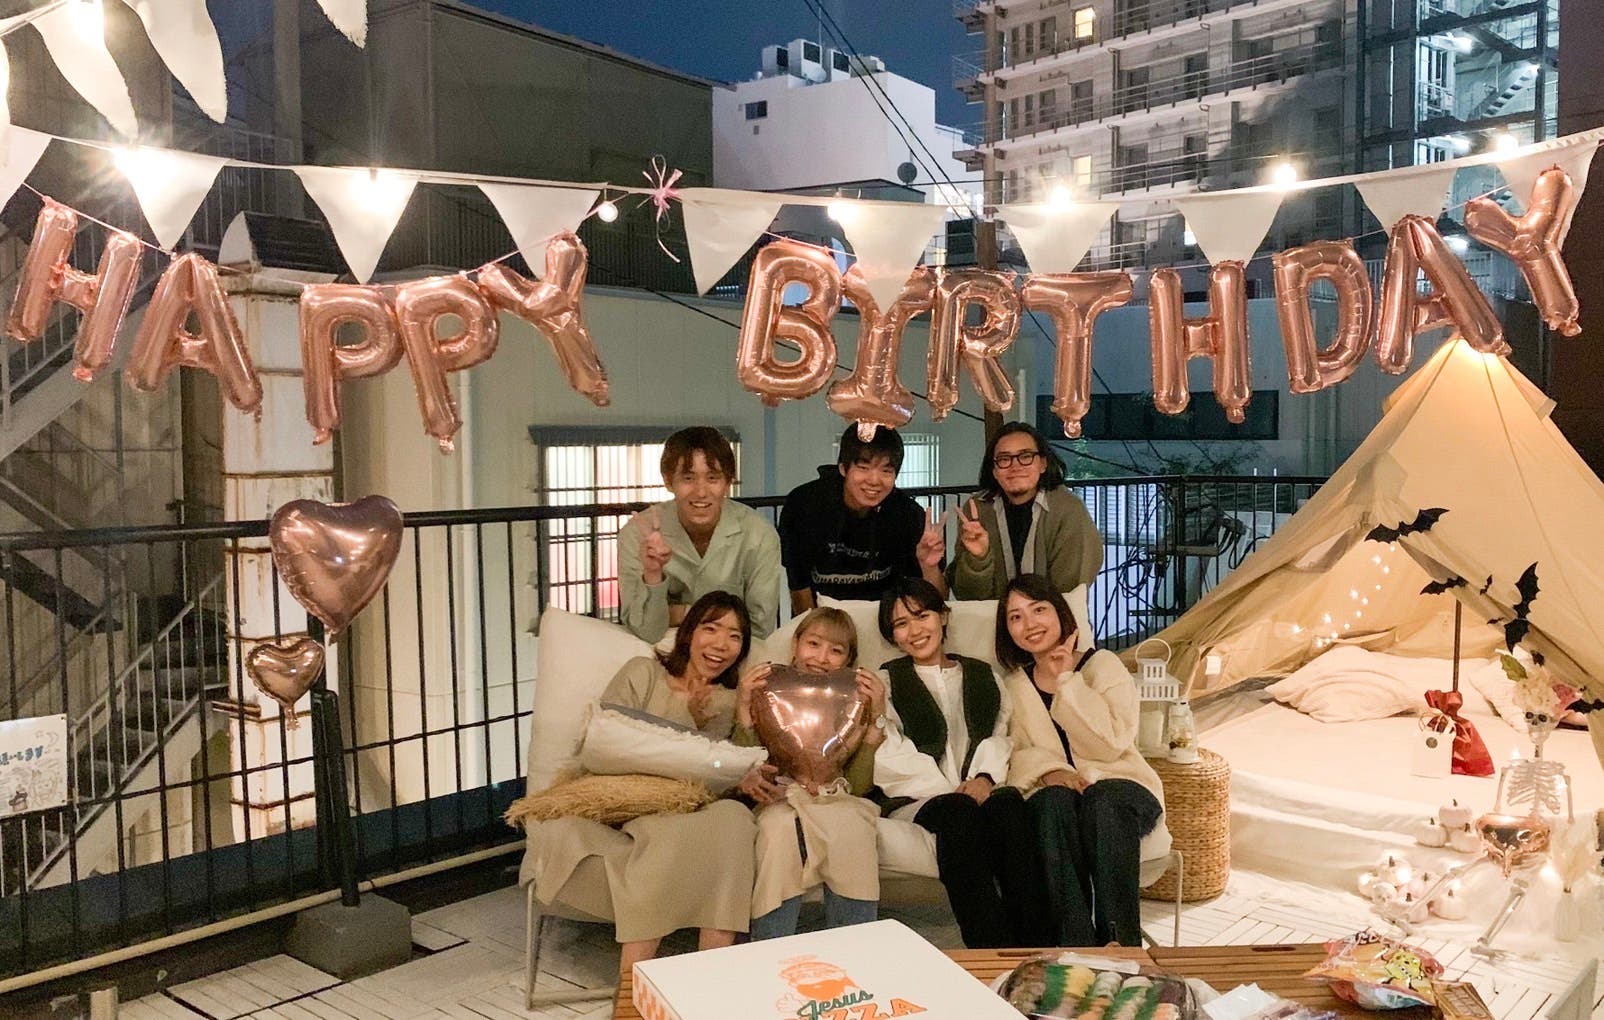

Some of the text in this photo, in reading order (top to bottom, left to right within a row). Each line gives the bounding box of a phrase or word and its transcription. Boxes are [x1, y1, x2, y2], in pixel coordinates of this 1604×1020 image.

[5, 165, 1582, 452] HAPPY BIRTHDAY
[783, 998, 929, 1020] ZZA
[797, 989, 874, 1020] Jesus
